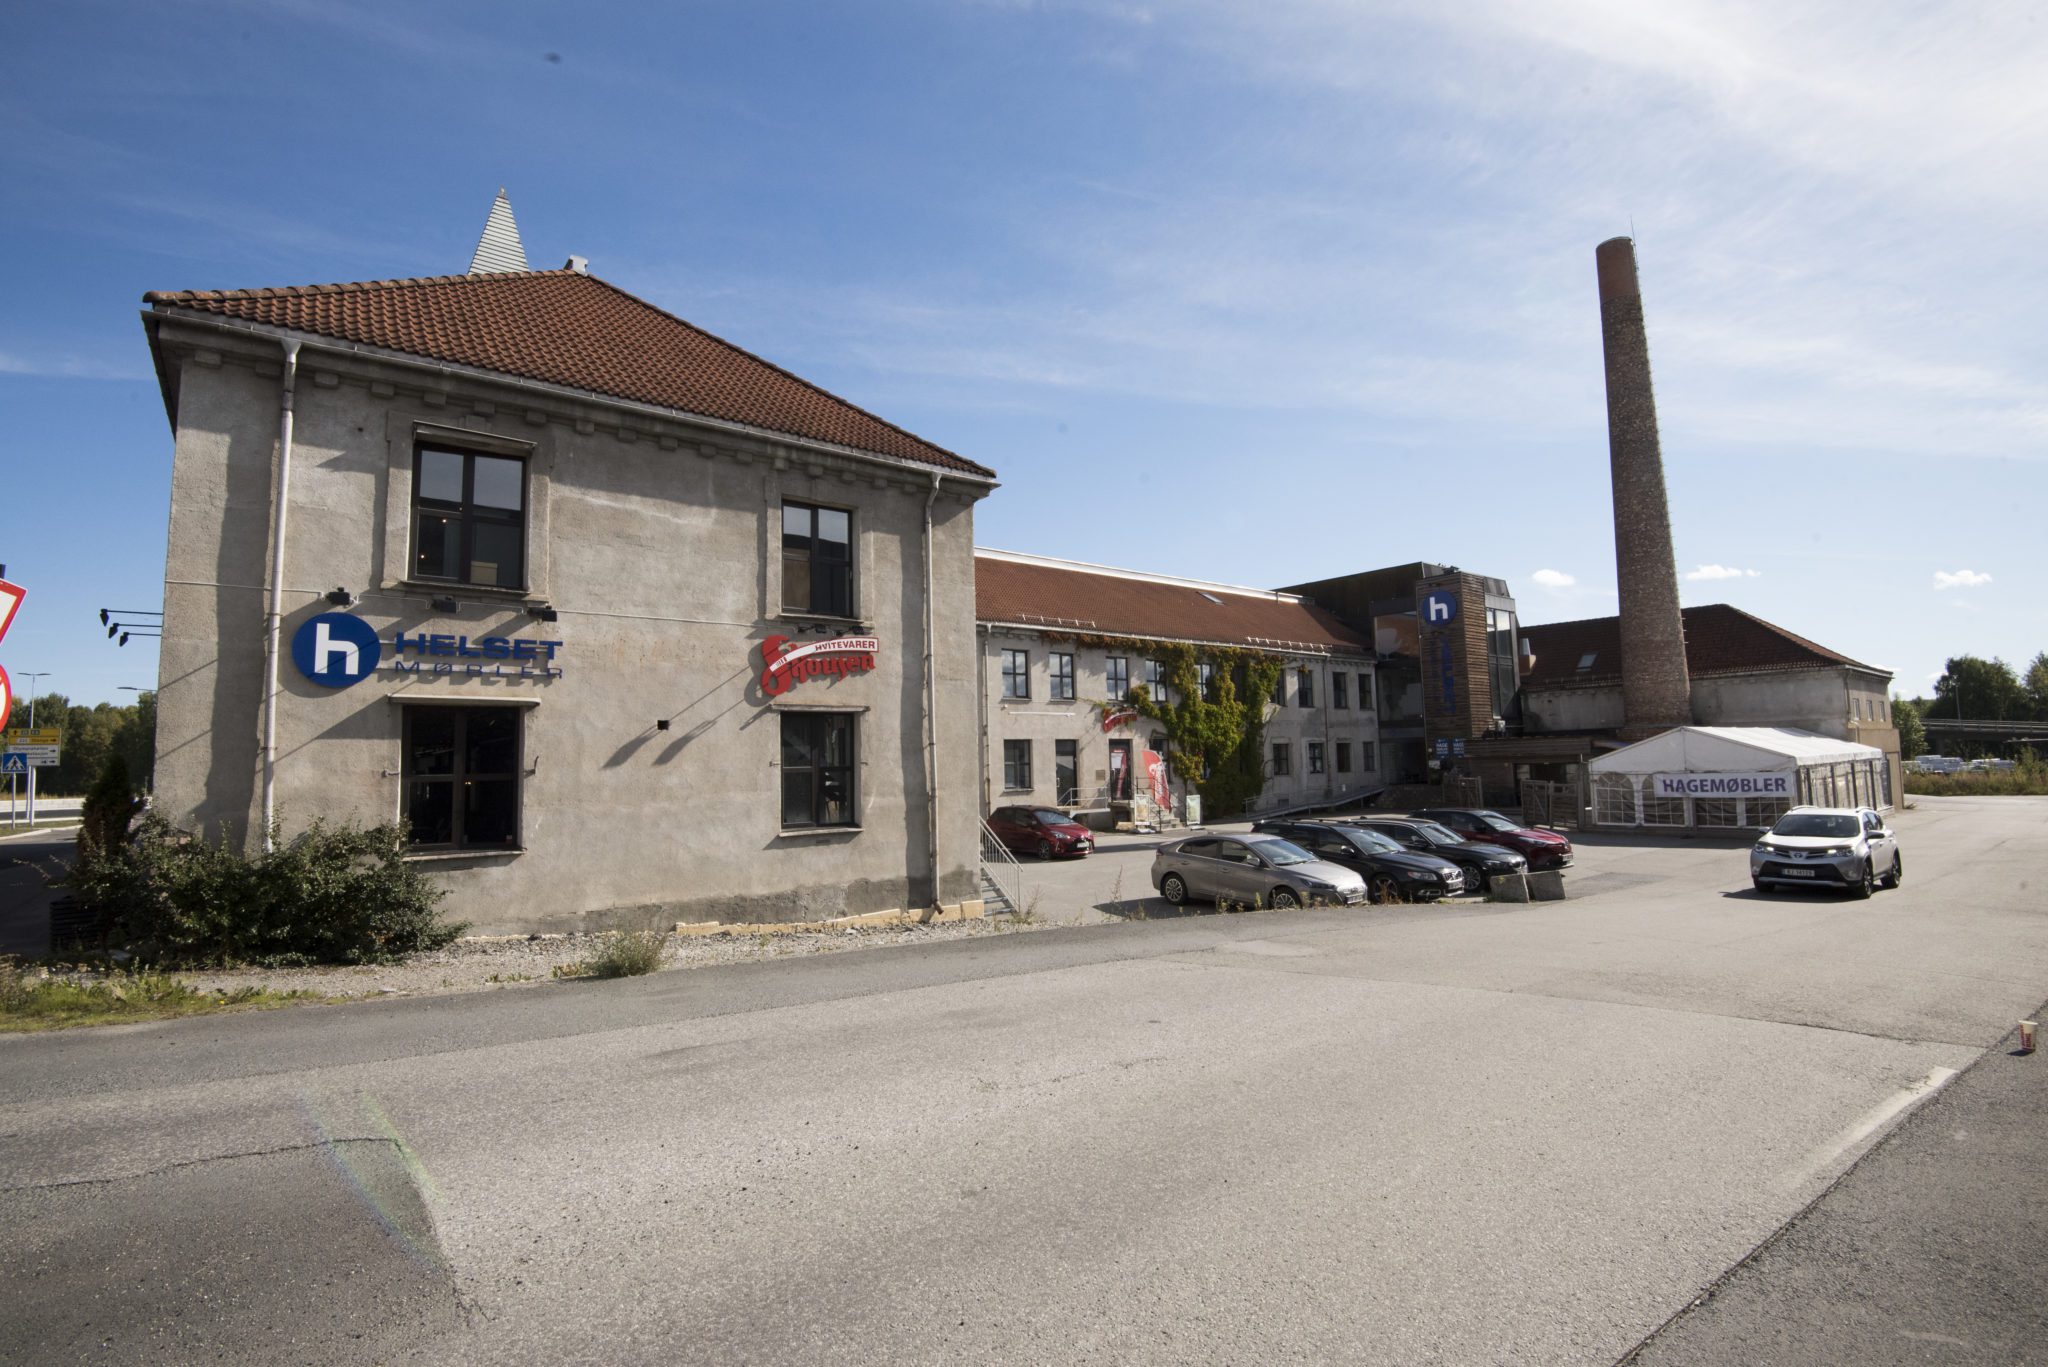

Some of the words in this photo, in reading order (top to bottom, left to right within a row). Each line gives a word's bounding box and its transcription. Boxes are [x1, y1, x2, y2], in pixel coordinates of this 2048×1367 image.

[1429, 596, 1449, 621] h
[314, 622, 360, 676] h
[395, 632, 563, 660] HELSET
[815, 640, 876, 652] HVITEVARER
[394, 660, 563, 680] MØBLER
[1662, 777, 1787, 794] HAGEMØBLER
